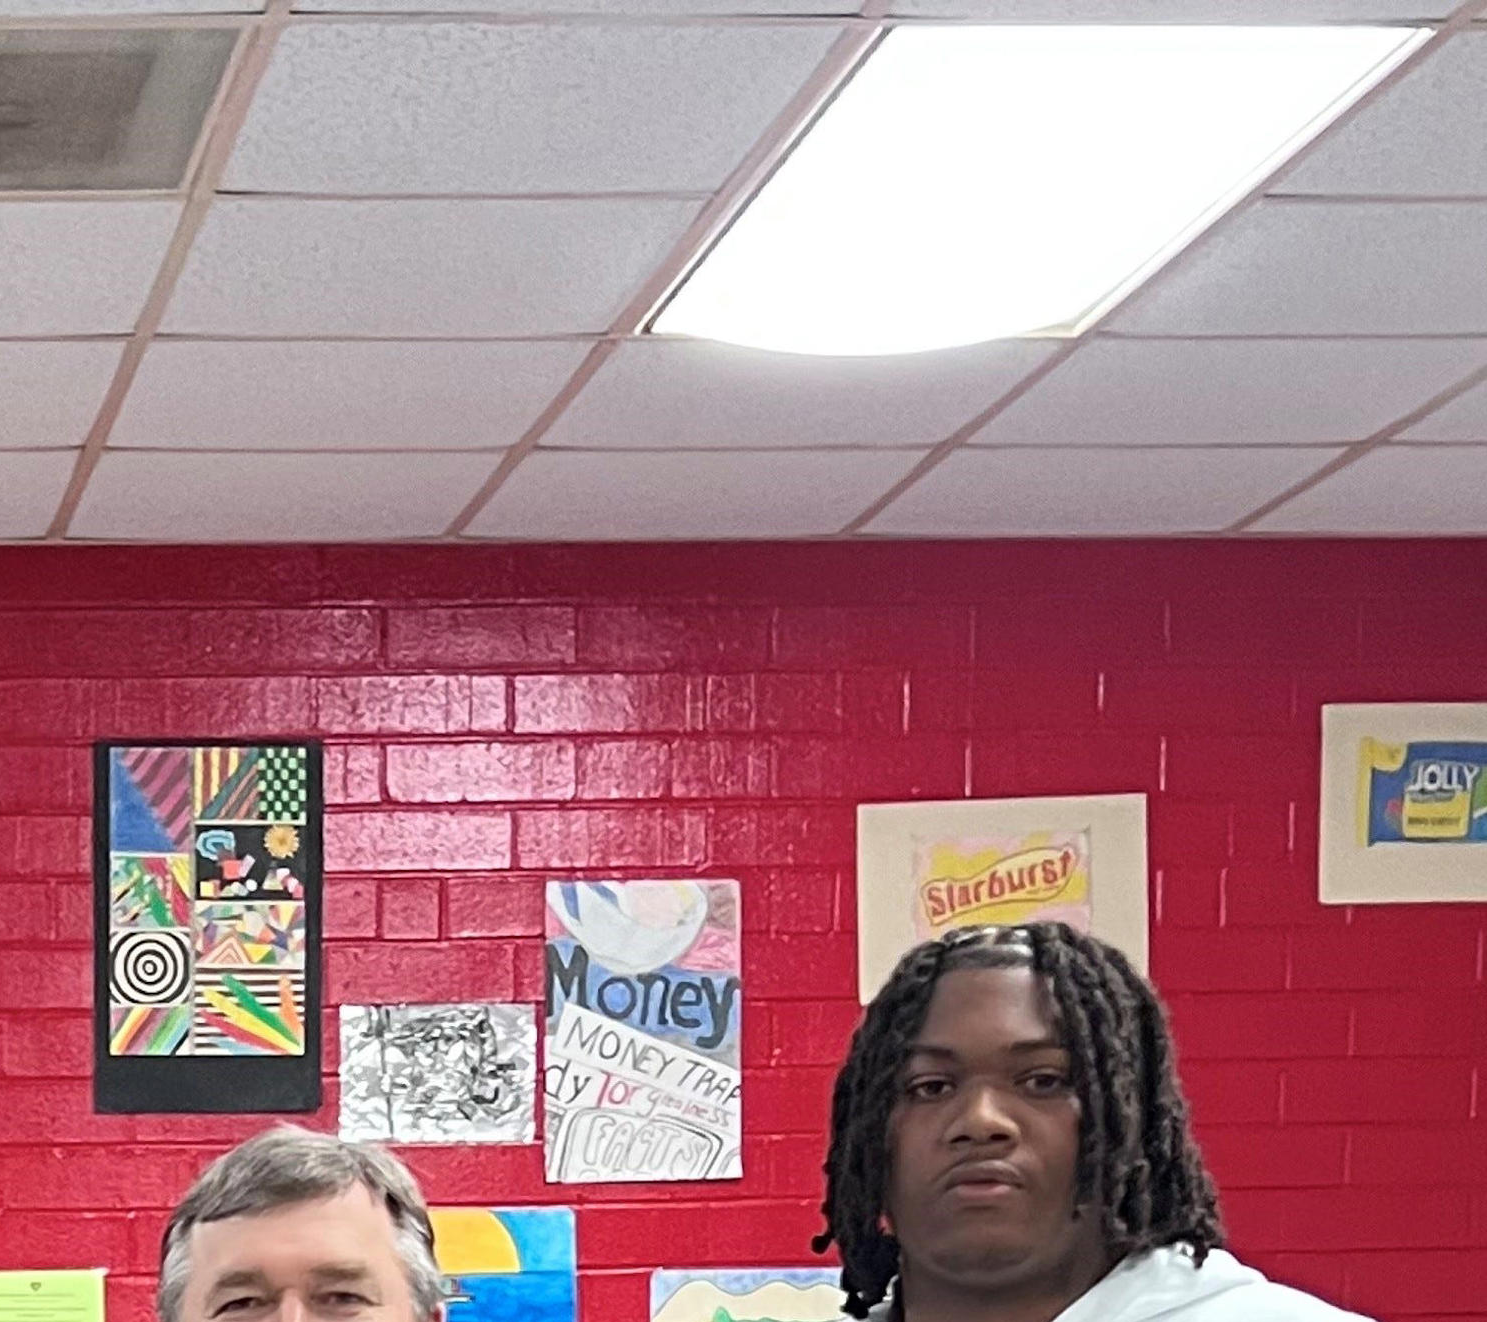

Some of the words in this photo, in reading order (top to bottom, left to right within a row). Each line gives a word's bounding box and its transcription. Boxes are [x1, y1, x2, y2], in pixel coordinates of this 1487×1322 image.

[1405, 763, 1480, 794] JOLLY
[927, 850, 1072, 917] Starburst
[545, 943, 740, 1050] Money
[565, 1016, 676, 1080] MONEY
